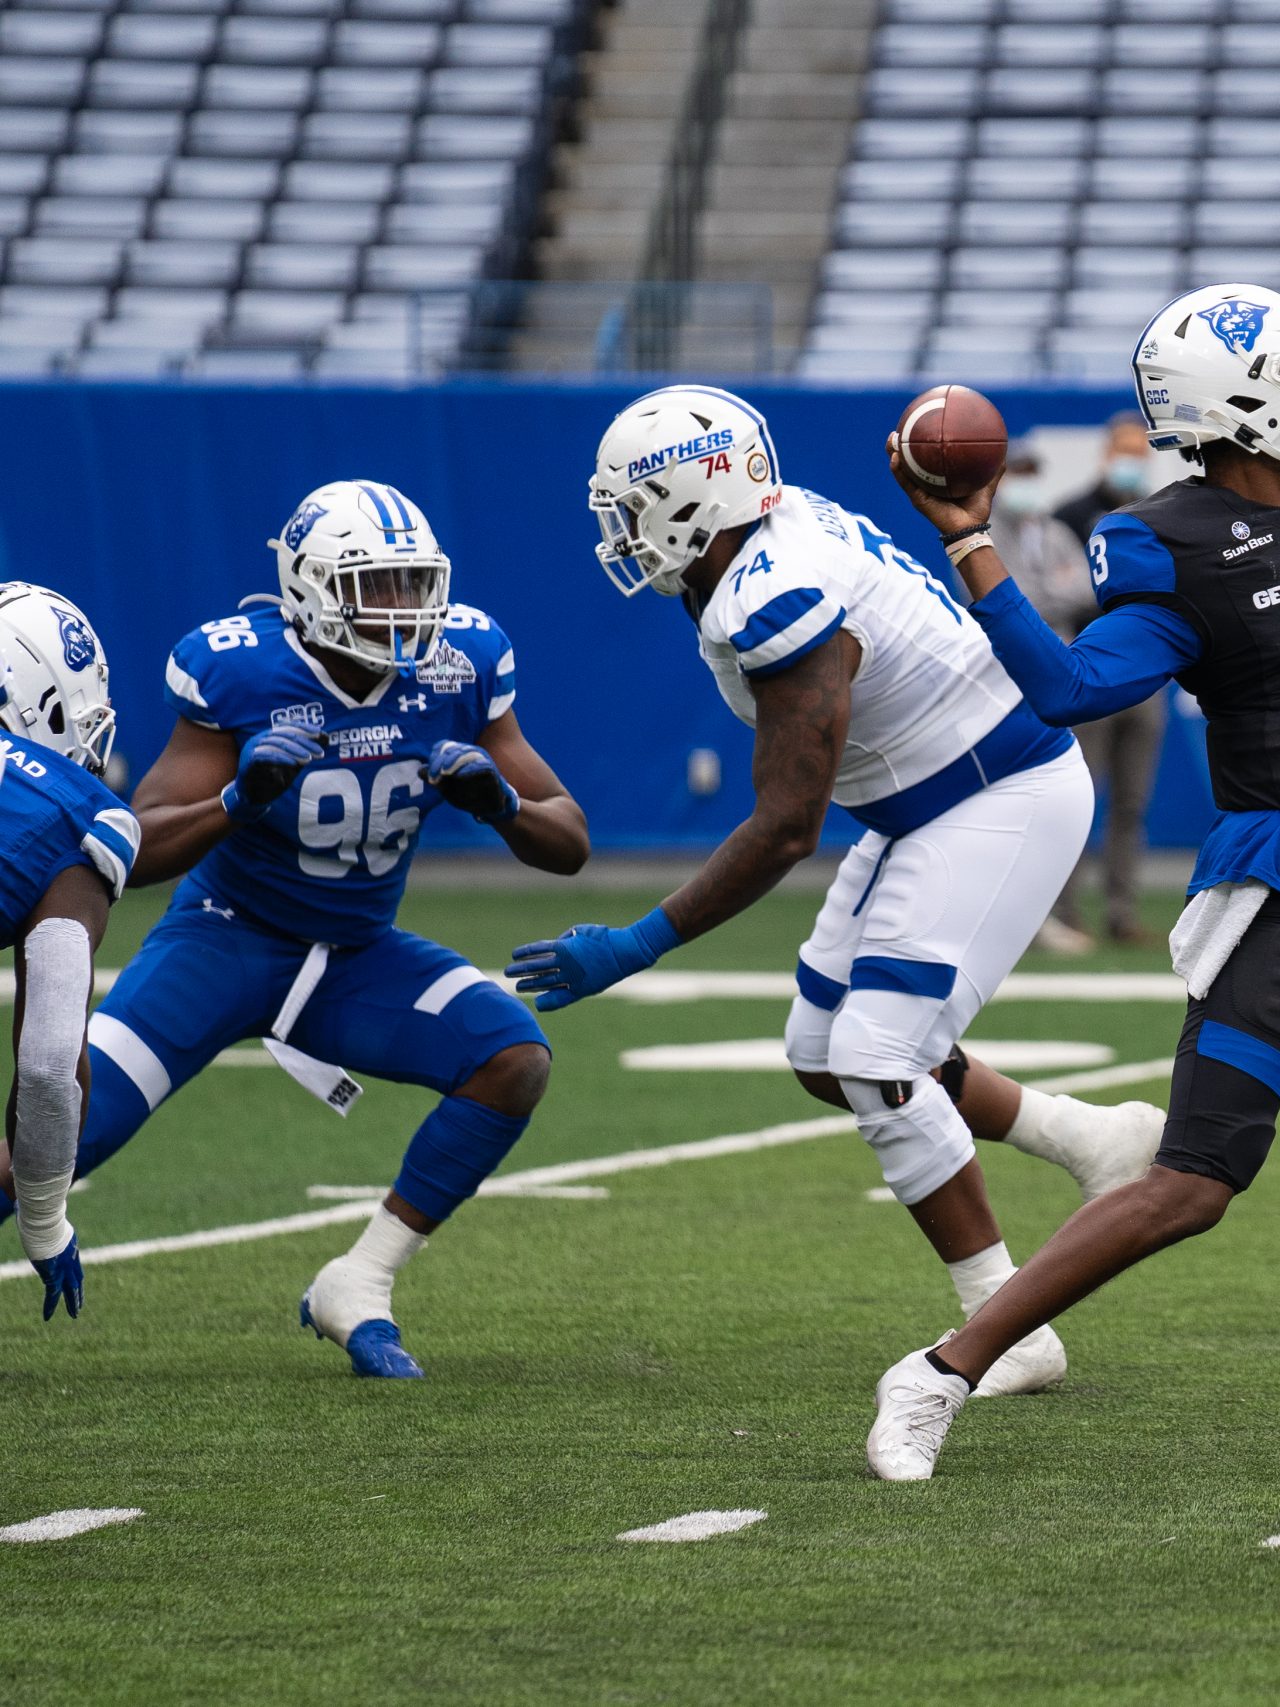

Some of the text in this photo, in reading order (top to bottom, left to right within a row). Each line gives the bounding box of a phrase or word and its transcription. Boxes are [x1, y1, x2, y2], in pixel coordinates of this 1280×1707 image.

[628, 429, 733, 478] PANTHERS
[698, 452, 732, 479] 74
[729, 549, 774, 595] 74
[1089, 533, 1109, 586] 3
[201, 615, 259, 652] 96
[435, 682, 459, 691] BOWL
[328, 724, 403, 746] GEORGIA
[339, 740, 394, 759] STATE
[298, 759, 424, 879] 96
